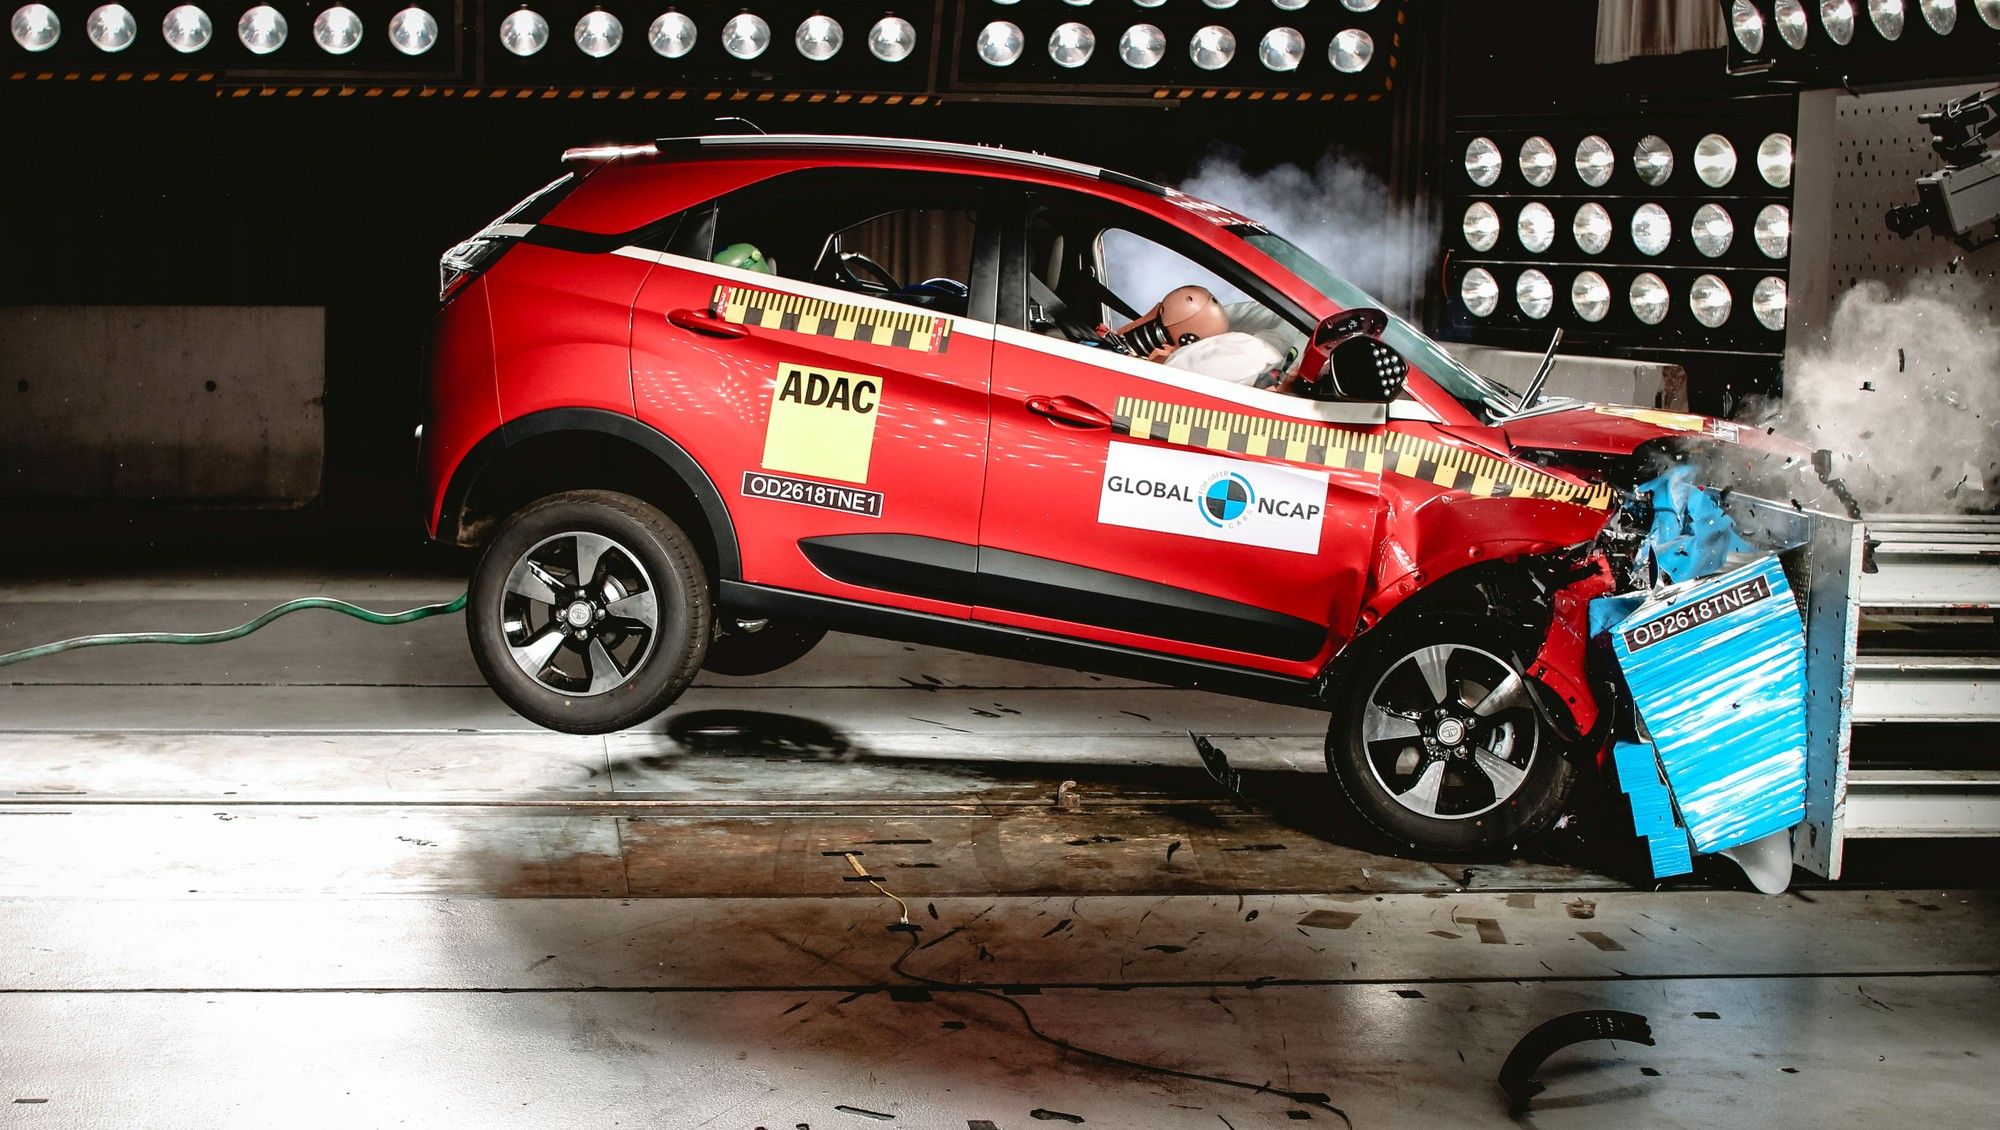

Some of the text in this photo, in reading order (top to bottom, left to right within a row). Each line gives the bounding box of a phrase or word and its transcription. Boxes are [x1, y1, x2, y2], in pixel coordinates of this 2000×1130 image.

[779, 370, 876, 414] ADAC
[750, 476, 876, 513] OD2618TNE1
[1108, 475, 1321, 521] GLOBAL NCAP
[1228, 509, 1253, 529] CARS
[1633, 580, 1766, 646] OD2618TNE1
